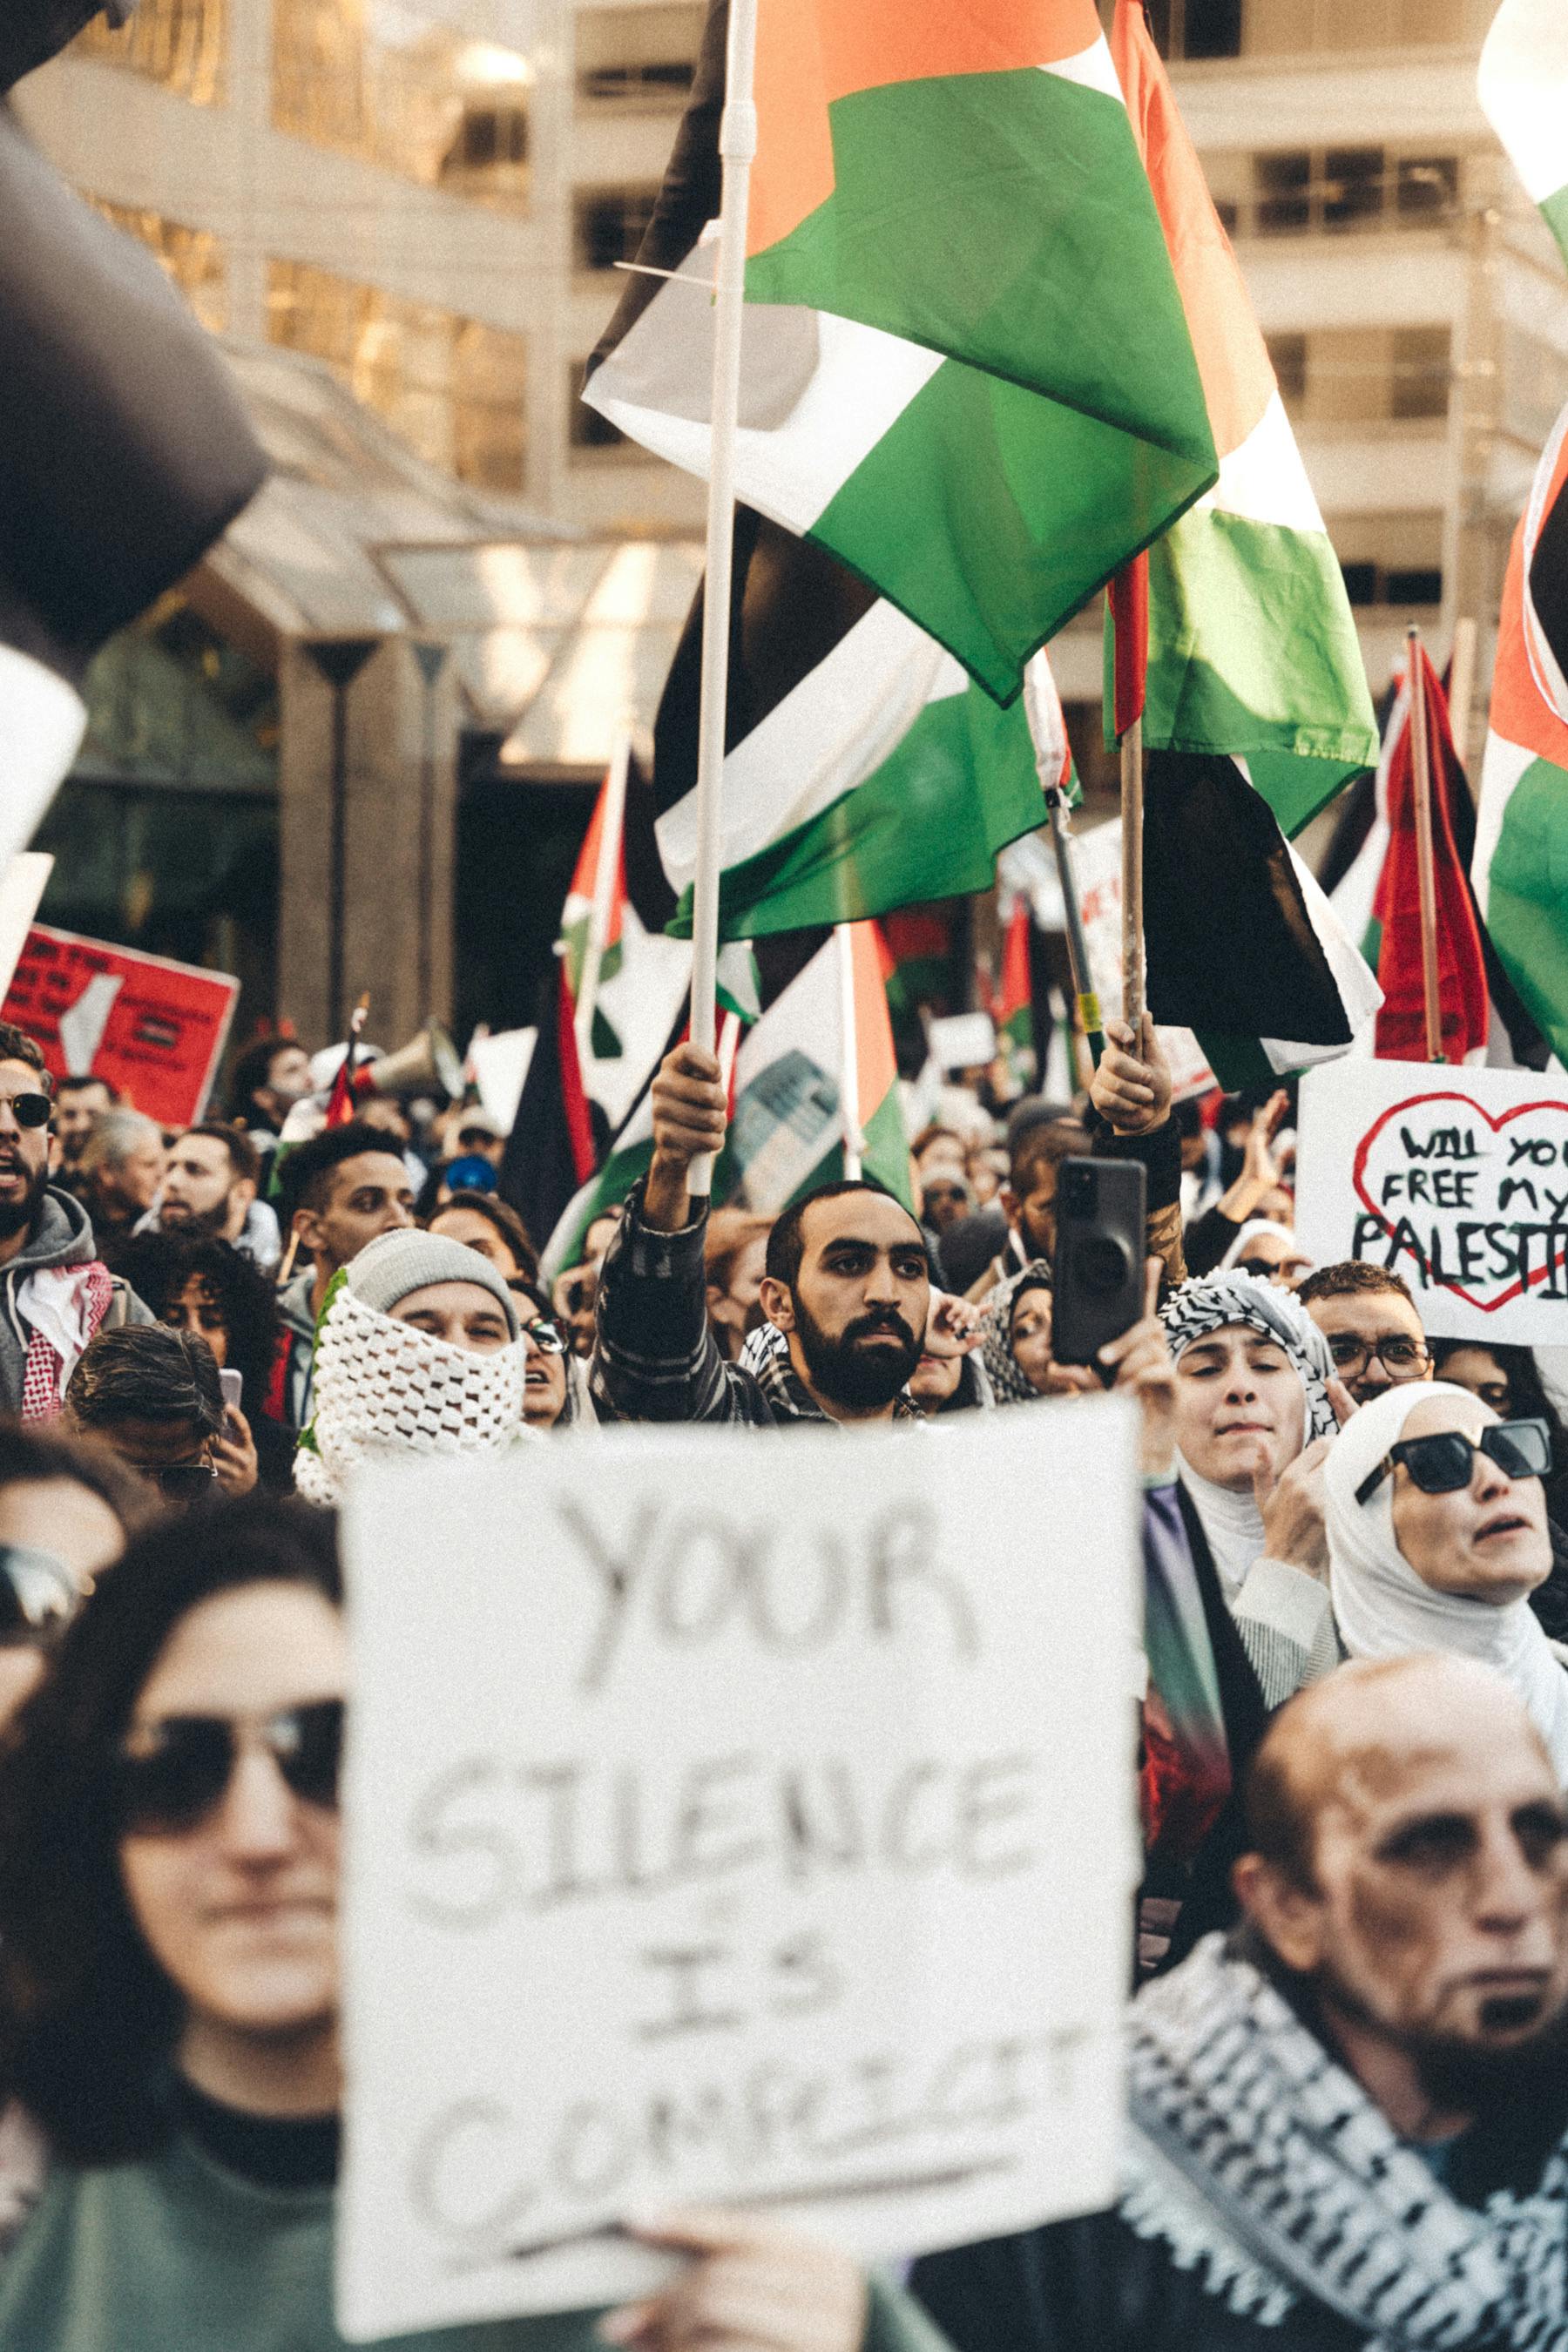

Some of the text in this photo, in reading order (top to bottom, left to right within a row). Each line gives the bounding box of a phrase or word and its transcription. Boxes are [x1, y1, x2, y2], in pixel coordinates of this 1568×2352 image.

[1382, 1168, 1568, 1225] FREE MY
[1400, 1126, 1568, 1167] WILL YO
[1352, 1213, 1568, 1301] PALESTI
[551, 1488, 984, 1699] YOUR
[404, 1749, 1037, 1930] SILENCE
[633, 1929, 844, 2045] IS
[409, 2025, 1092, 2240] COMPLICIT
